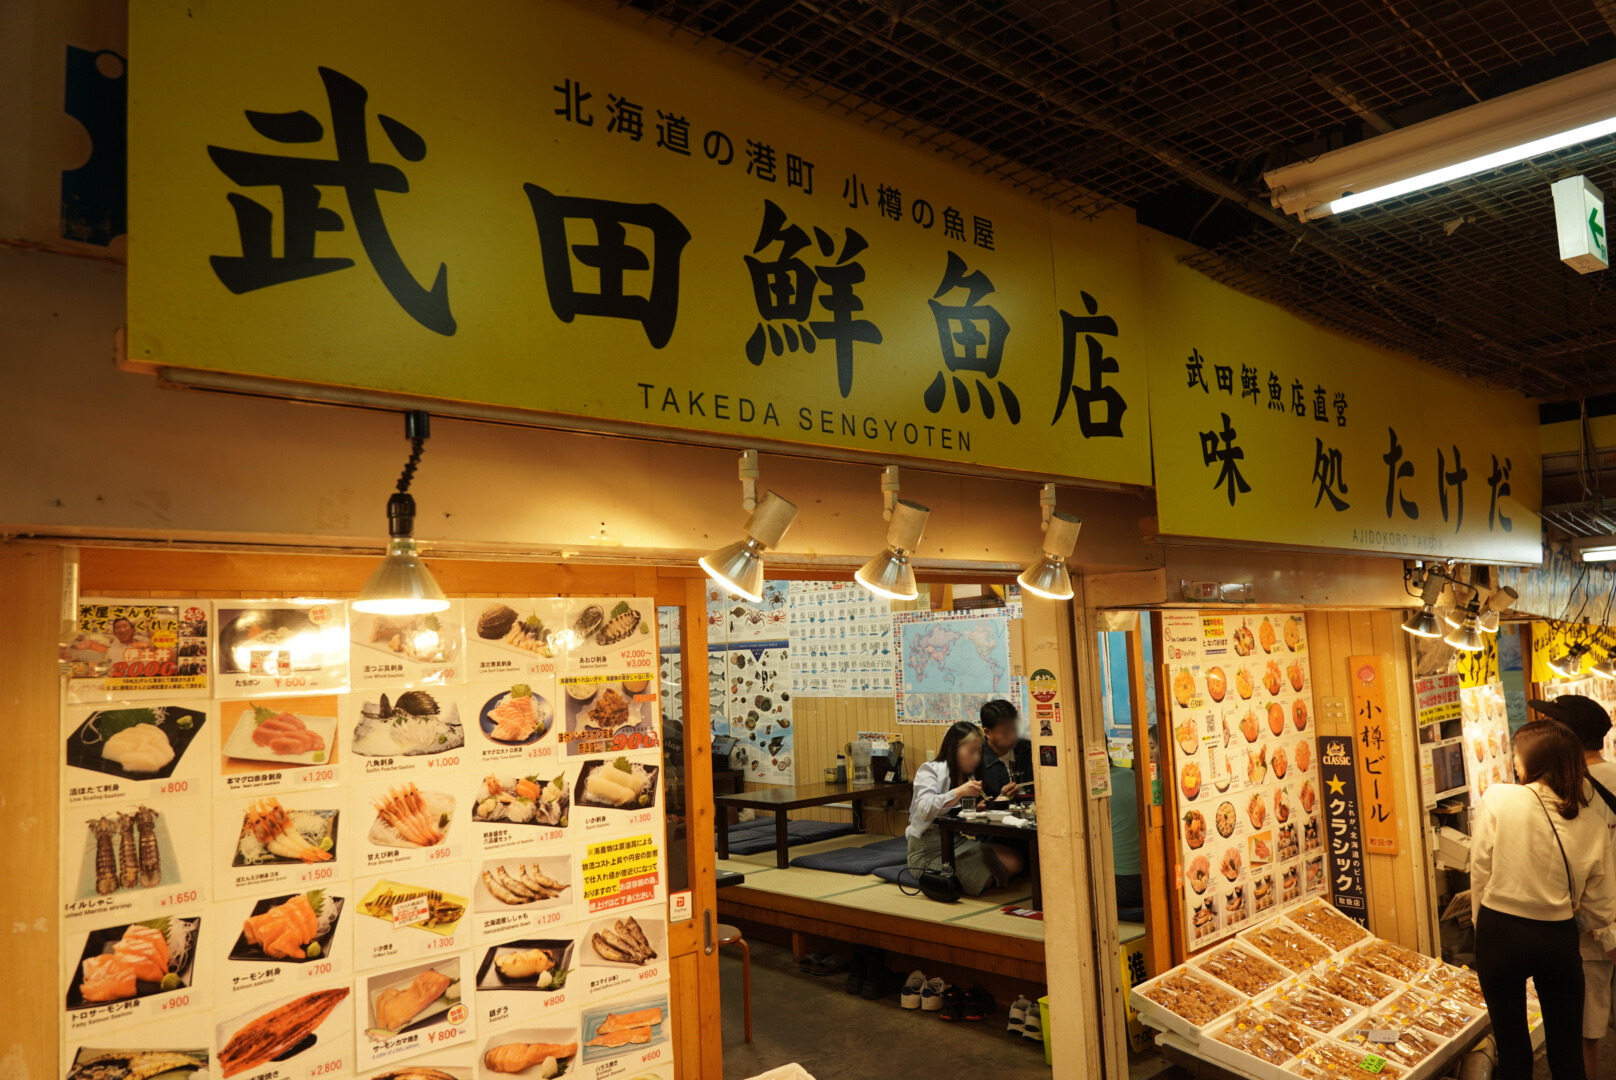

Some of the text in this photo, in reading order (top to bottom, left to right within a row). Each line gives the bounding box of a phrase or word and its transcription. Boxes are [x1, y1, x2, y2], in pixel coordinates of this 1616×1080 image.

[554, 78, 995, 251] 北海道の港町 小樽の魚屋
[207, 66, 1128, 439] 武田鮮魚店
[1186, 347, 1348, 427] 武田鮮魚店直営
[637, 382, 972, 452] TAKEDA SENGYOTEN
[1353, 529, 1408, 547] AJIDOKORO
[1323, 755, 1351, 766] CLASSIC
[1360, 699, 1391, 822] 小樽ビール
[161, 781, 188, 793] ¥800
[1329, 798, 1353, 892] クラシック
[232, 963, 332, 985] サーモン刺身 ¥700
[72, 995, 190, 1022] トロサーモン刺身 ¥900
[543, 995, 565, 1008] ¥800
